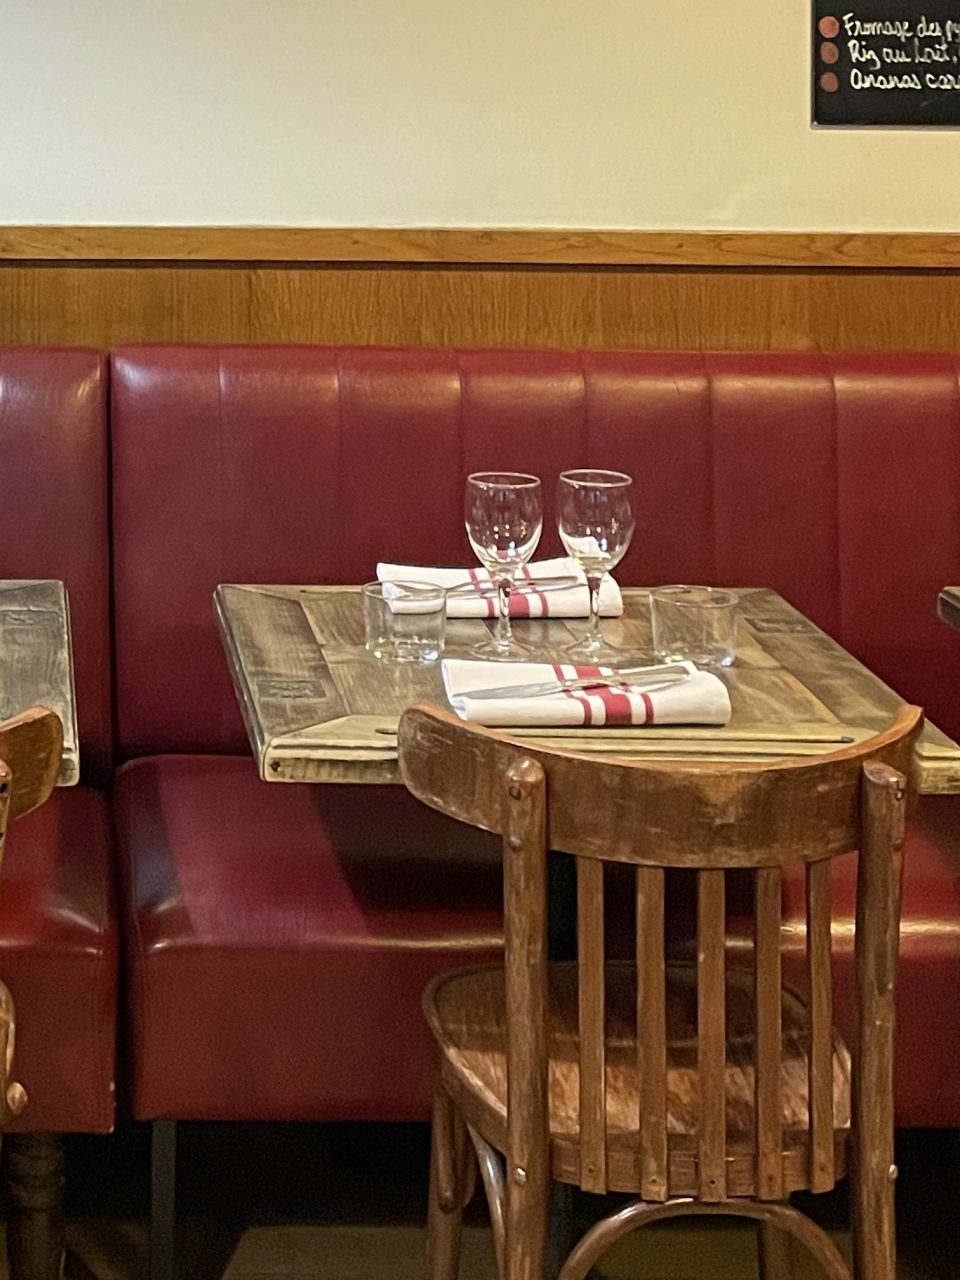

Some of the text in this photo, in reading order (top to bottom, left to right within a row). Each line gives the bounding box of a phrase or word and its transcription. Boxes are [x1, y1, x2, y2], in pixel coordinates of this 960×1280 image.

[842, 13, 913, 42] Fromage
[917, 16, 942, 37] des
[847, 39, 880, 70] Riz
[883, 47, 911, 63] au
[850, 68, 922, 89] Ananas
